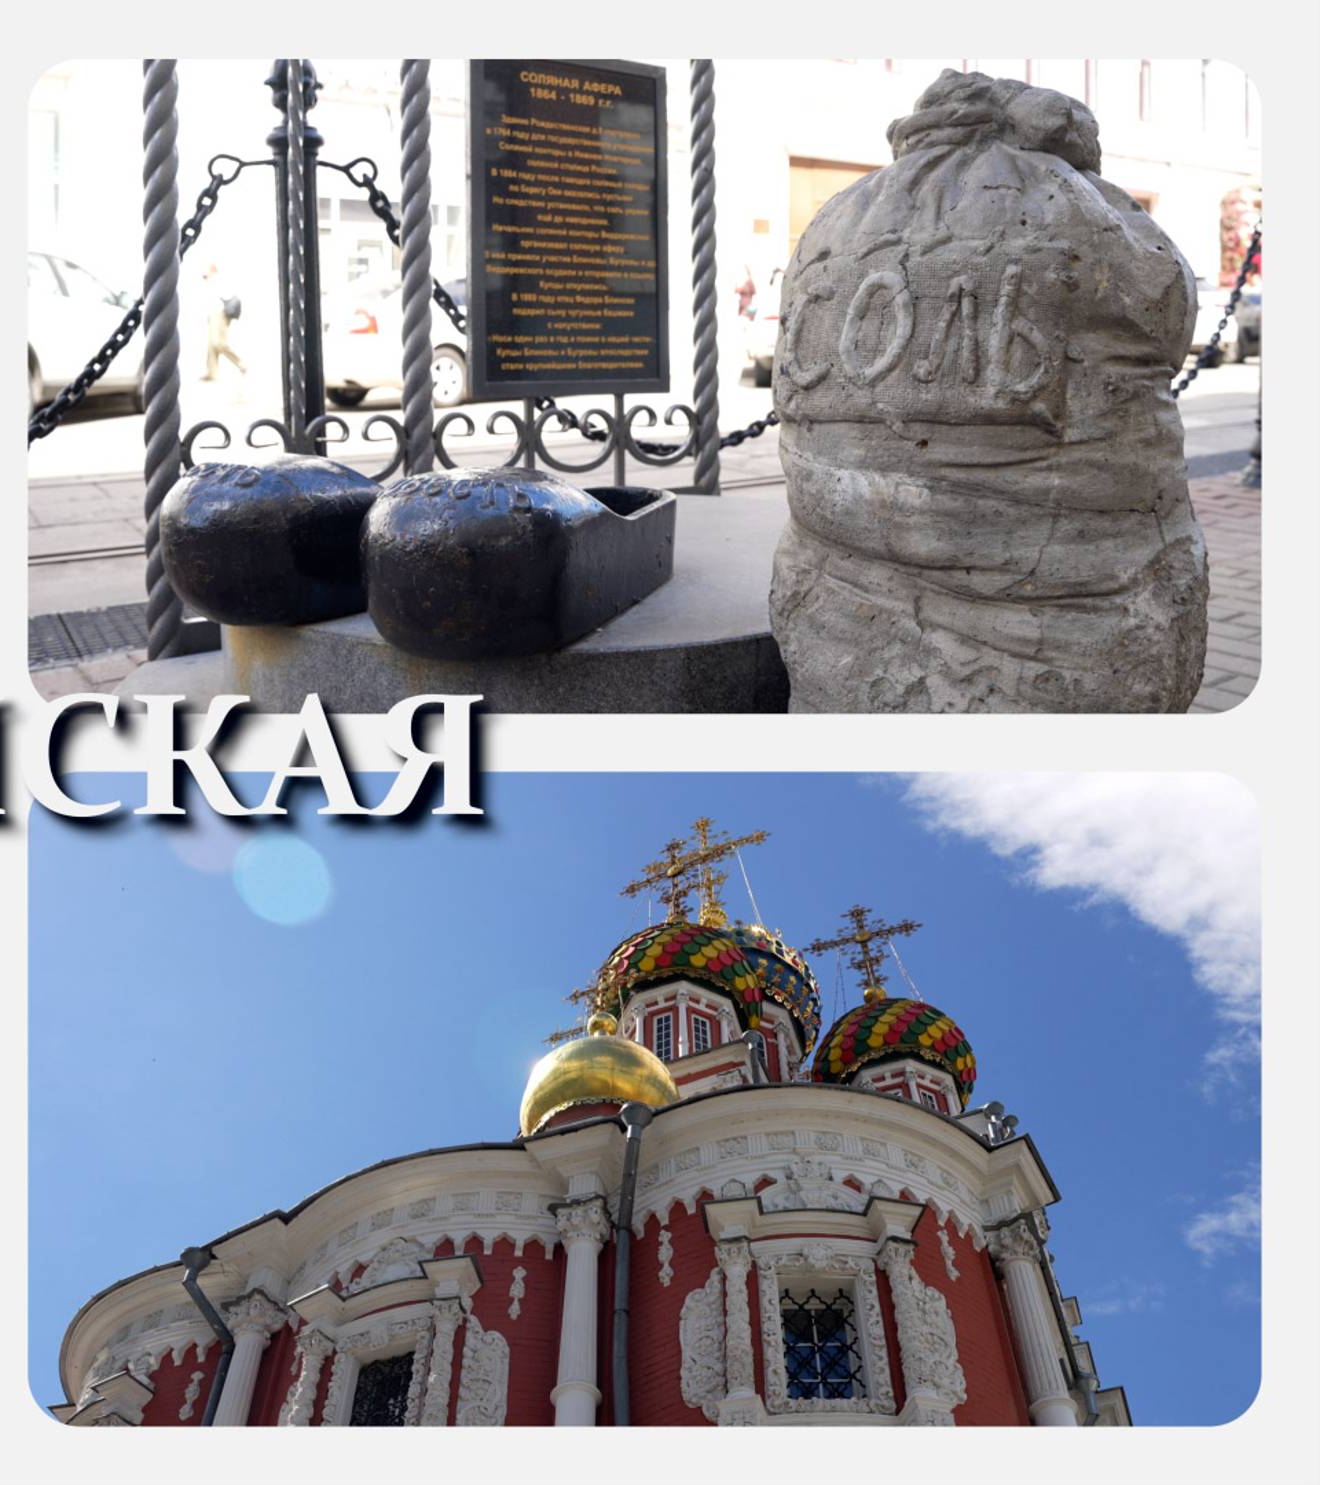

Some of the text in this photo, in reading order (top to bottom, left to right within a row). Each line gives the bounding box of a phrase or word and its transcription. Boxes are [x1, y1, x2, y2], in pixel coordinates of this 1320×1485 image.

[520, 71, 622, 96] СОЛЯНАЯ АФЕРА
[784, 262, 1053, 401] СОЛЬ
